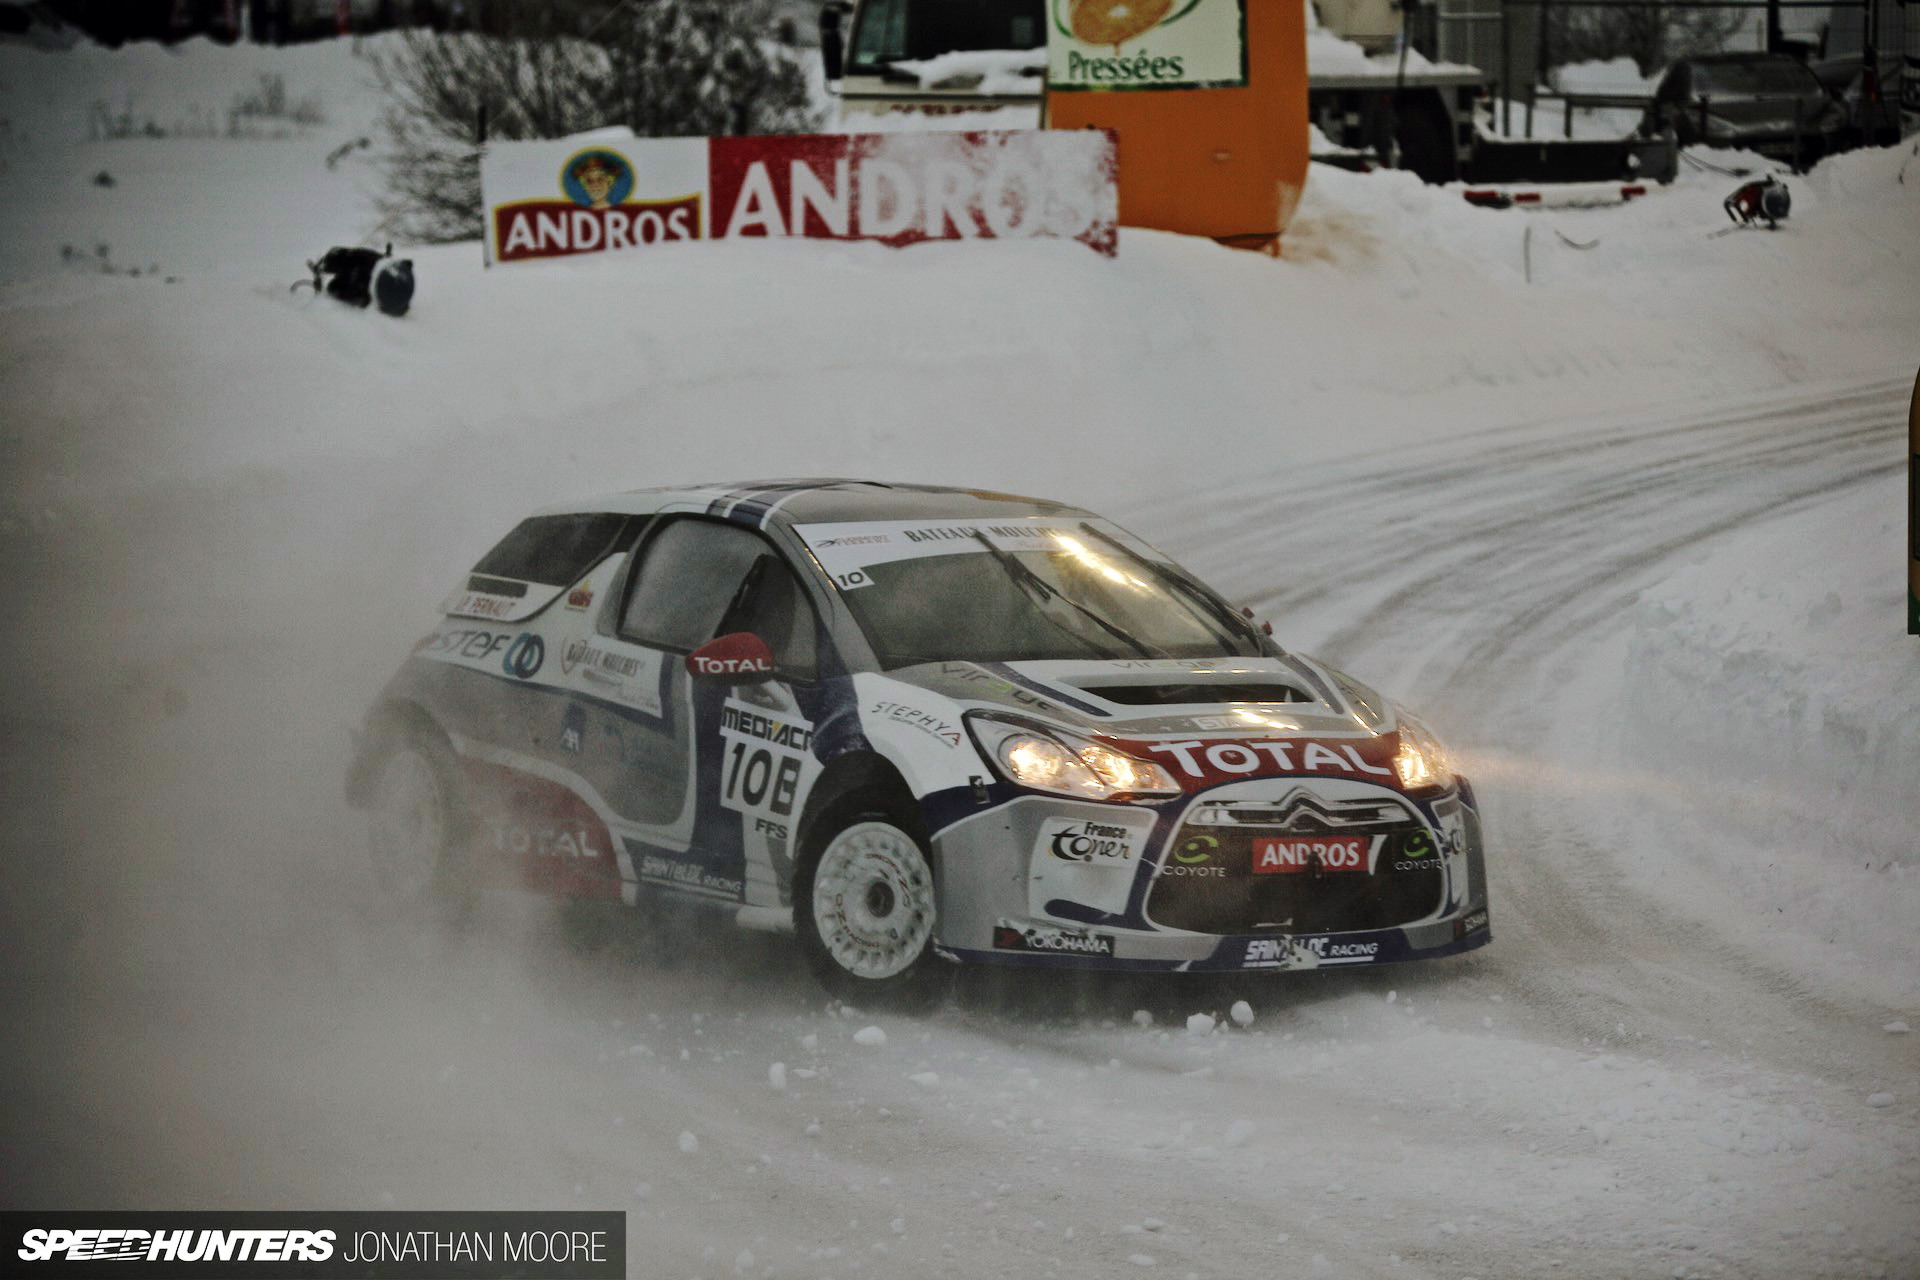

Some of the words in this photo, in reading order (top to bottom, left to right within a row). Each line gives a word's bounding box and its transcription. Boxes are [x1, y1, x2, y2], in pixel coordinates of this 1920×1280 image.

[1068, 49, 1184, 80] Pressées
[724, 157, 1088, 238] ANDRO
[504, 207, 690, 254] ANDROS
[837, 571, 865, 587] 10
[871, 701, 961, 746] STEPHYA
[1148, 740, 1393, 778] TOTAL
[725, 741, 803, 817] 10B
[754, 818, 789, 840] FFS
[1083, 821, 1128, 839] France
[1260, 841, 1360, 868] ANDROS
[1161, 864, 1227, 878] COYOTE
[1329, 942, 1379, 956] RACING
